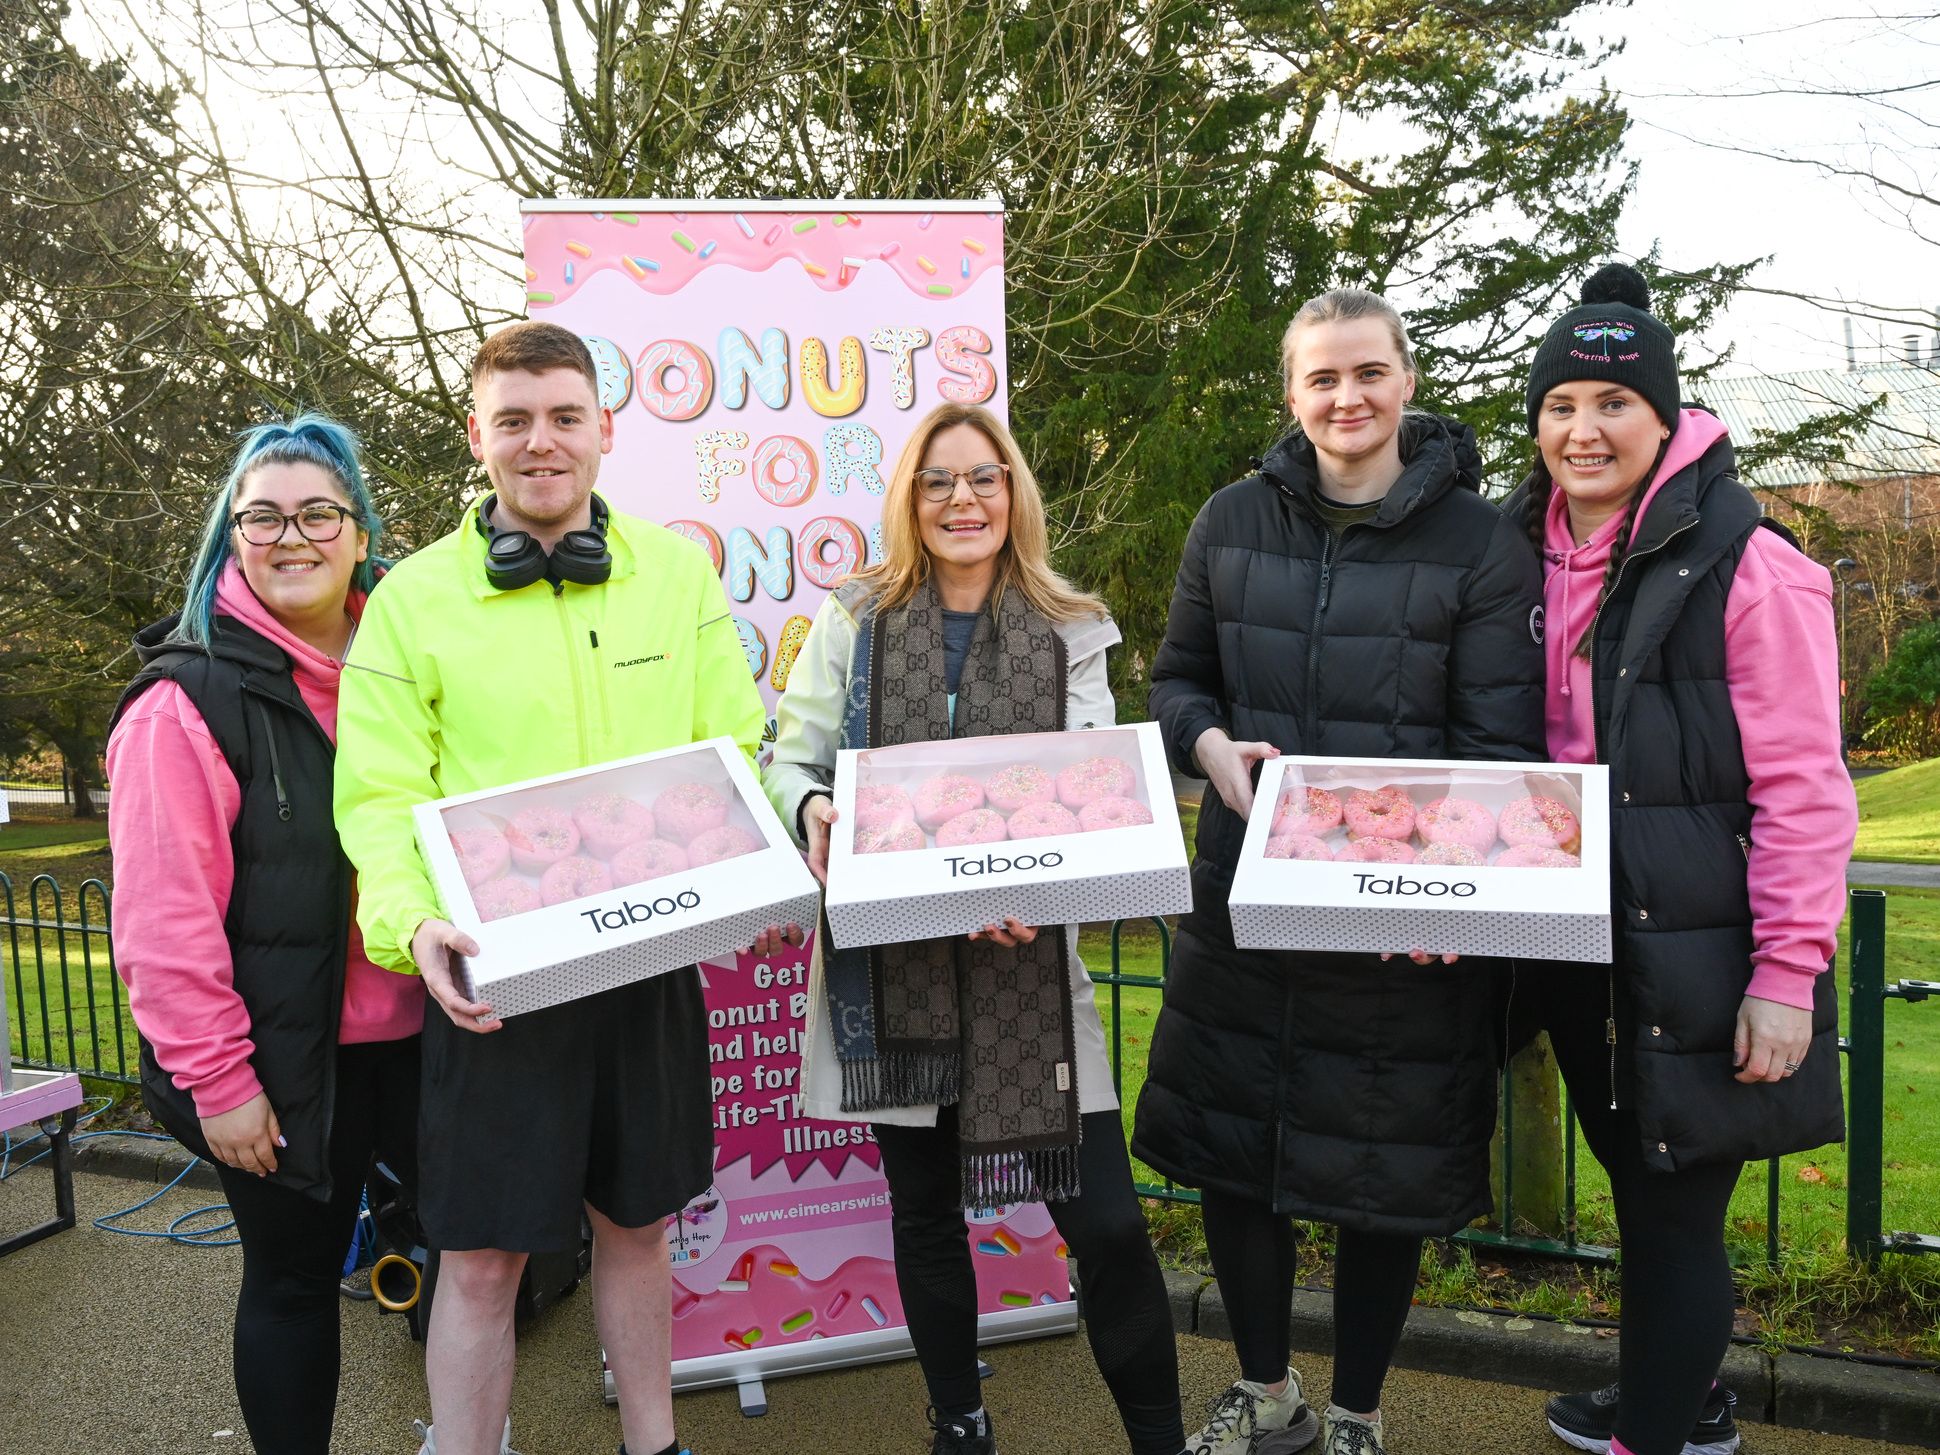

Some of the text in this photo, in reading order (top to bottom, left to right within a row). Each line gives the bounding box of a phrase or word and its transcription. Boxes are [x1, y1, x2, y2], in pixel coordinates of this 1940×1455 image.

[1615, 321, 1635, 331] Wish
[1570, 349, 1640, 363] Creating Hope
[694, 422, 886, 507] FOR
[614, 654, 664, 668] MUDDYFOX
[754, 961, 805, 988] Get
[709, 998, 780, 1028] onut
[709, 1034, 743, 1062] nd
[712, 1065, 798, 1103] pe for
[713, 1093, 801, 1129] ife-T
[784, 1123, 878, 1153] Illness
[692, 1232, 711, 1242] Hope
